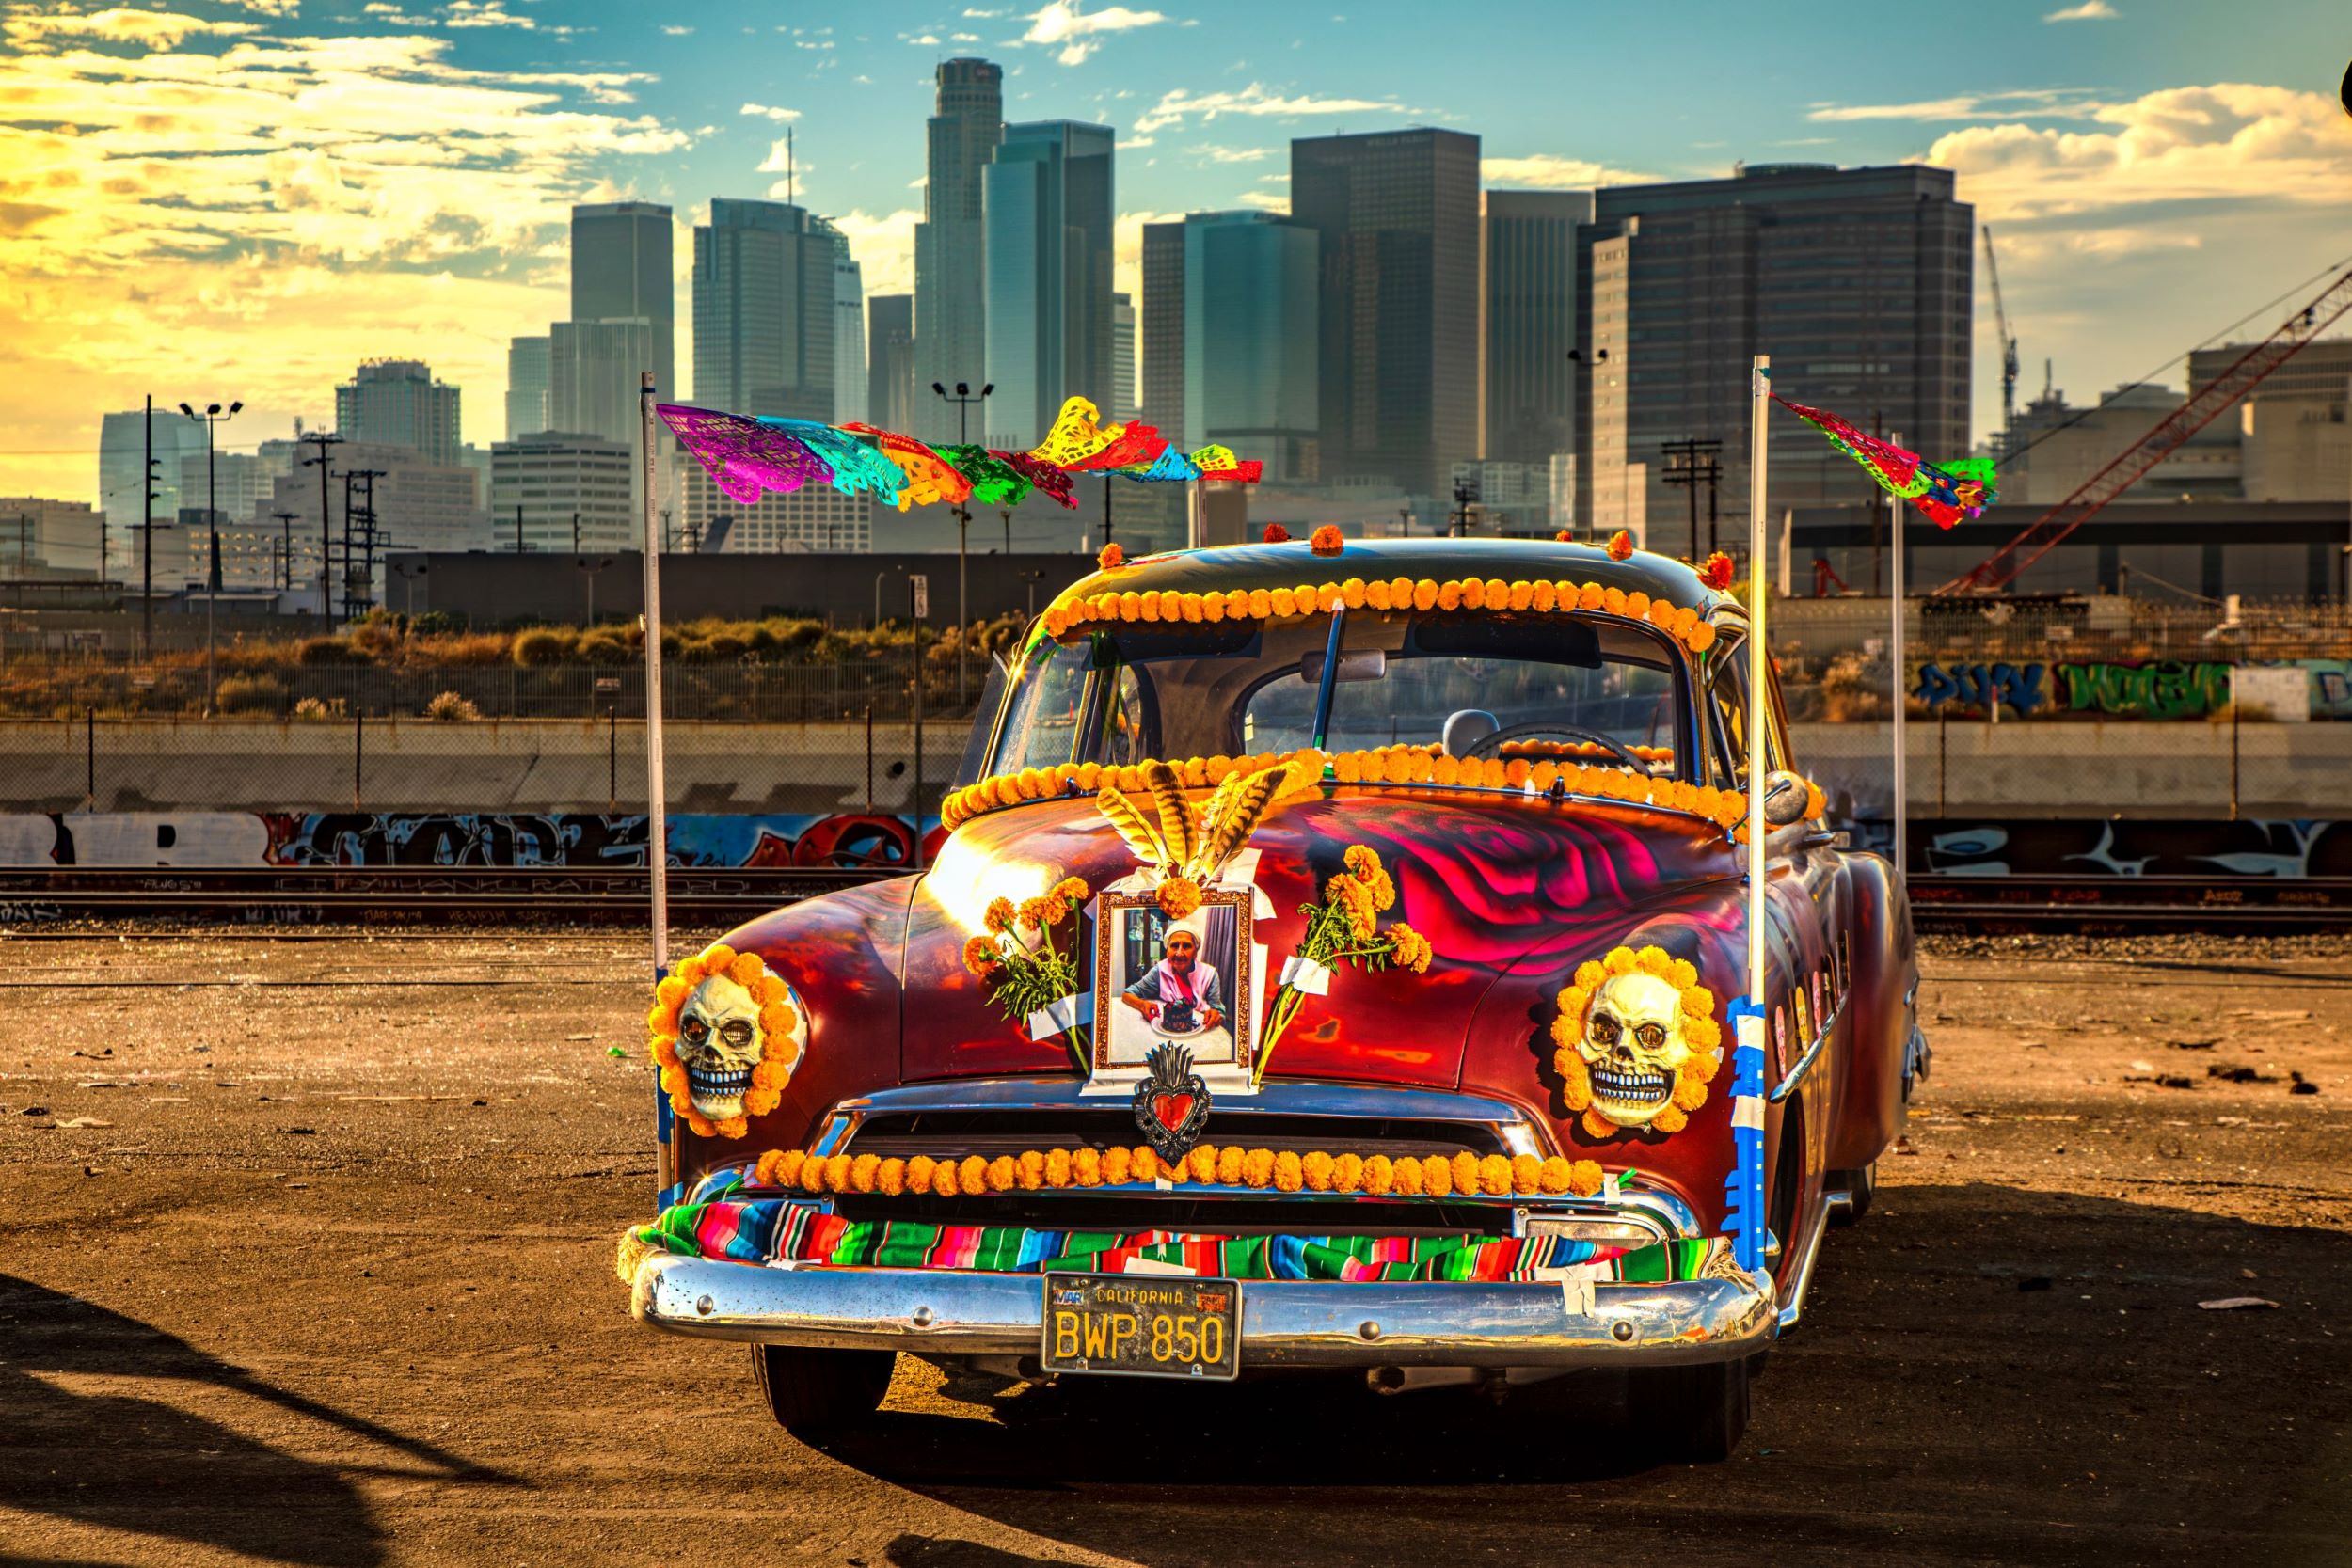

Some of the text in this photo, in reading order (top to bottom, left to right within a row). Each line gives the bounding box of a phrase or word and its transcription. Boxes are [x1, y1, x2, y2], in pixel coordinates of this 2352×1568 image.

[1097, 1289, 1183, 1305] CALIFORNIA
[1055, 1311, 1223, 1363] BWP 850
